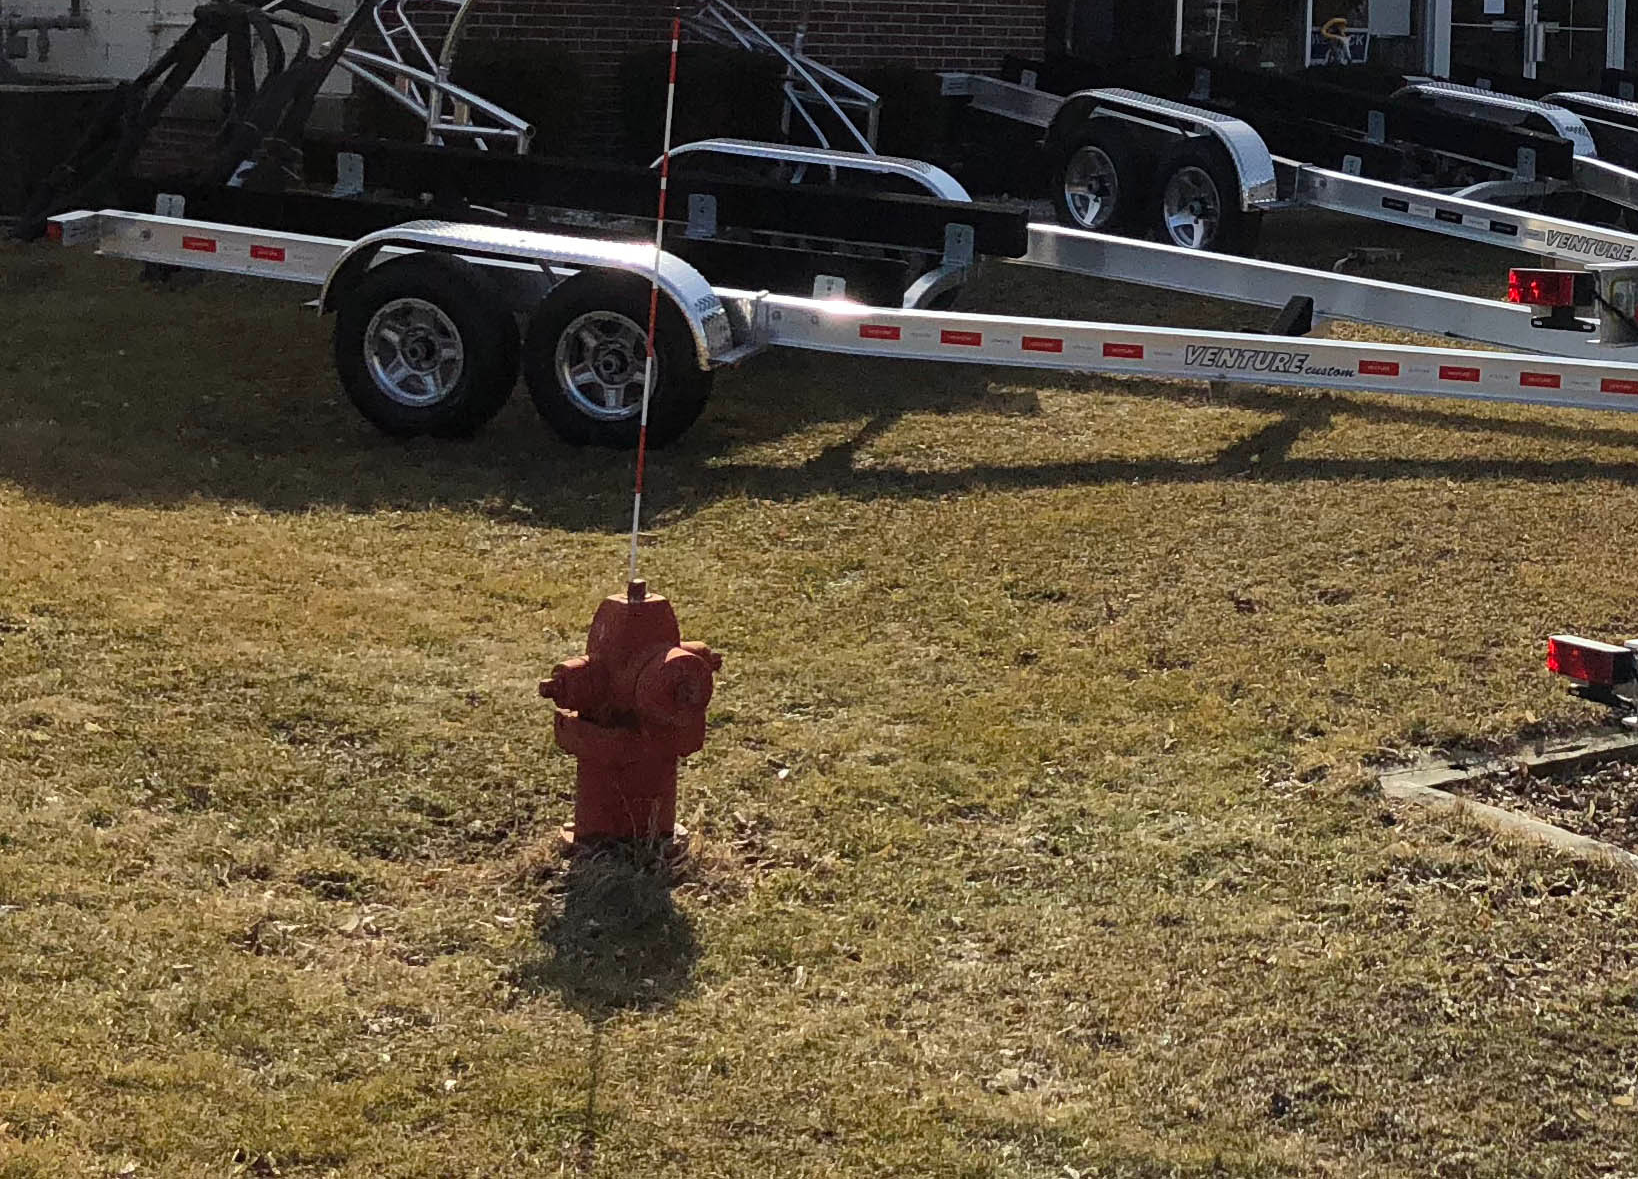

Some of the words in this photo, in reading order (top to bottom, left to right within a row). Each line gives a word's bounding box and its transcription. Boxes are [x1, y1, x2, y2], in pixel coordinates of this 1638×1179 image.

[1545, 229, 1635, 262] VENTURE
[1184, 344, 1310, 374] VENTURE
[1304, 366, 1356, 378] custom
